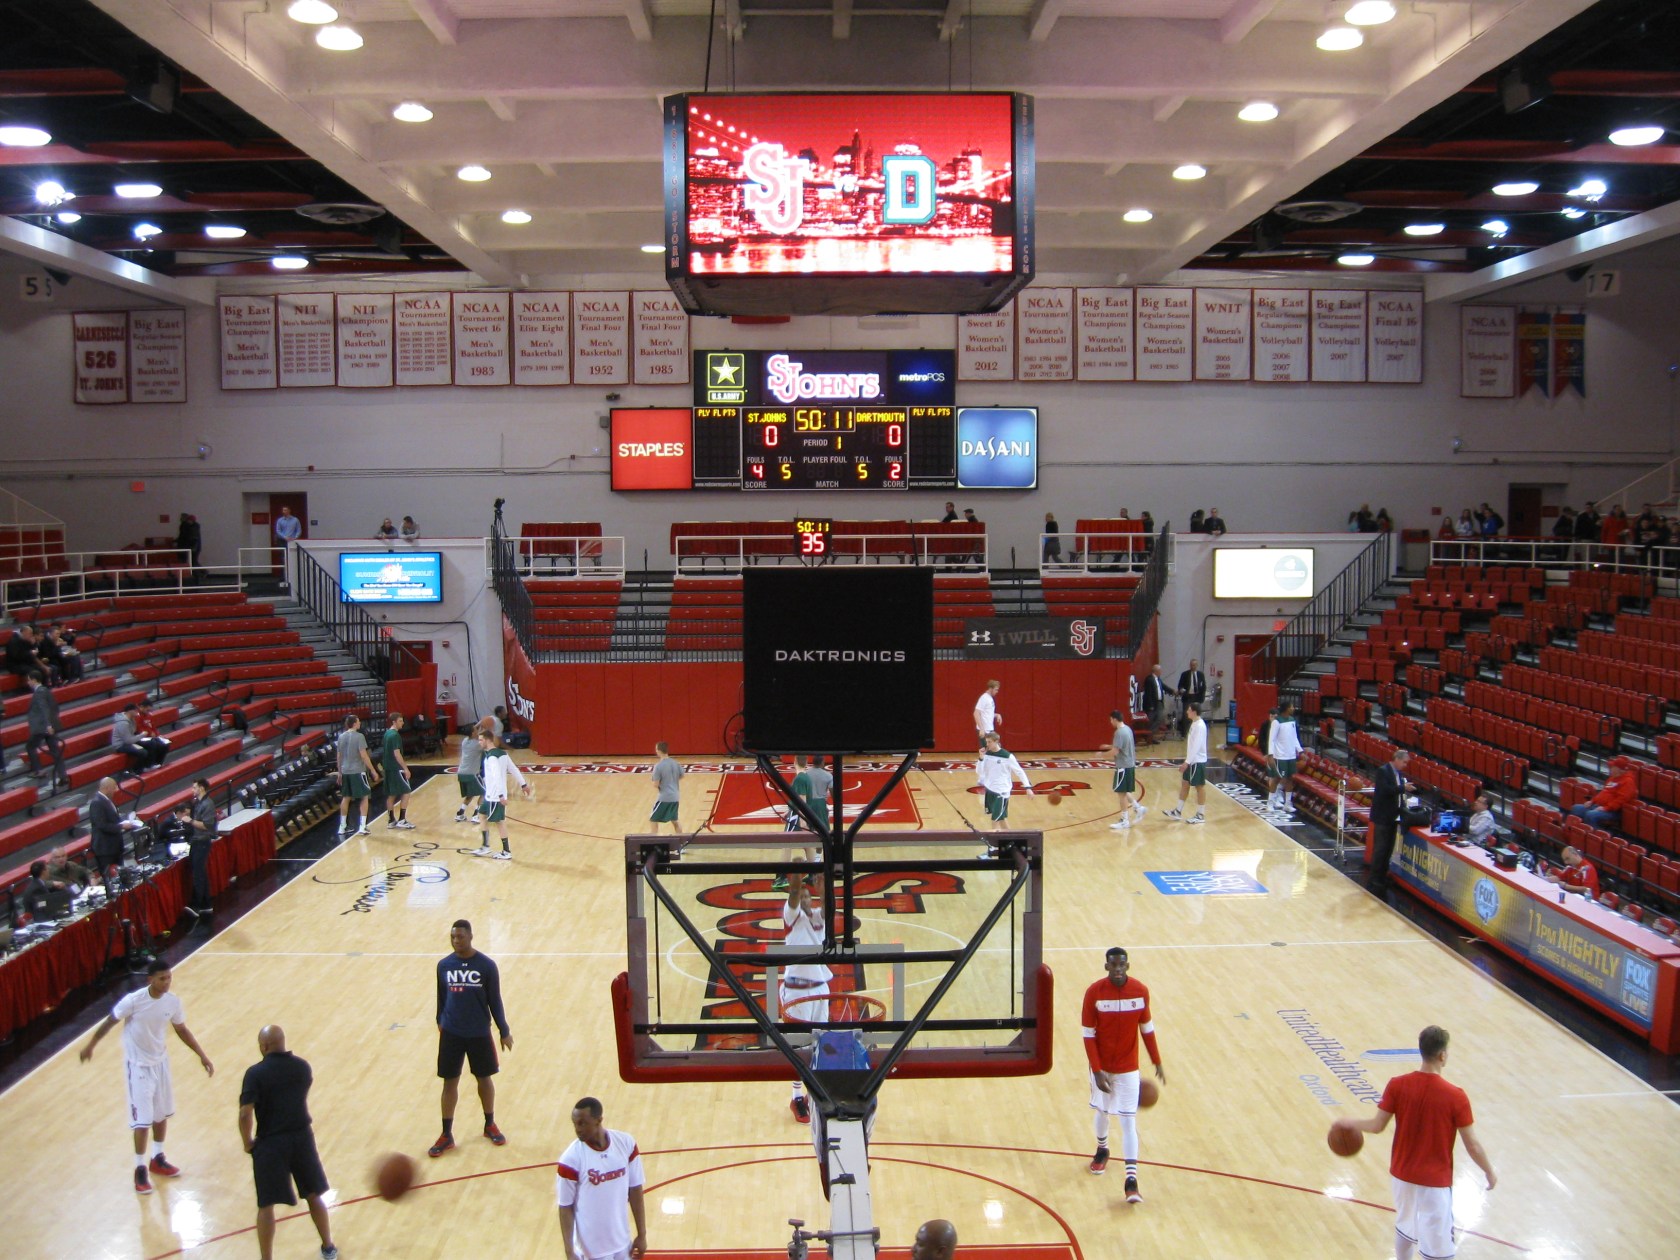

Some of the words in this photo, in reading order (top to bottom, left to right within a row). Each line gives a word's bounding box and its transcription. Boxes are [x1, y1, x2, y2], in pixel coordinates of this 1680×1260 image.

[882, 155, 937, 224] D
[404, 300, 441, 310] NCAA
[463, 303, 501, 313] NCAA
[522, 303, 560, 313] NCAA
[583, 302, 620, 312] NCAA
[643, 302, 680, 311] NCAA
[1028, 298, 1064, 308] NCAA
[1082, 297, 1100, 310] Big
[1105, 297, 1128, 307] East
[1141, 298, 1160, 310] Big
[1165, 298, 1187, 307] East
[1204, 303, 1242, 313] WNIT
[1258, 298, 1276, 310] Big
[1281, 298, 1304, 307] East
[1316, 300, 1333, 312] Big
[1339, 300, 1361, 309] East
[1378, 301, 1414, 311] NCAA
[224, 305, 242, 318] Big
[248, 305, 270, 315] East
[294, 305, 319, 315] NIT
[353, 305, 377, 315] NIT
[1139, 312, 1165, 320] Regular
[134, 320, 152, 332] Big
[157, 319, 180, 328] East
[342, 317, 388, 326] Champions
[1084, 321, 1126, 329] Champions
[1143, 322, 1185, 331] Champions
[1260, 322, 1302, 331] Champions
[1318, 322, 1360, 331] Champions
[1375, 317, 1401, 326] Final
[542, 325, 564, 334] Eight
[641, 323, 661, 331] Final
[227, 329, 269, 337] Champions
[1025, 336, 1067, 344] Basketball
[1147, 337, 1182, 345] Women's
[1203, 336, 1244, 344] Basketball
[1261, 337, 1303, 347] Volleyball
[1318, 337, 1360, 348] Volleyball
[1375, 338, 1416, 349] Volleyball
[237, 343, 260, 351] Men's
[1143, 346, 1185, 354] Basketball
[85, 351, 117, 368] 526
[227, 353, 269, 361] Basketball
[471, 367, 495, 376] 1983
[589, 366, 613, 375] 1952
[650, 365, 674, 374] 1985
[975, 362, 998, 371] 2012
[899, 372, 945, 382] metroPCS
[698, 409, 710, 417] PLY
[713, 409, 722, 417] FL
[723, 409, 736, 417] PTS
[913, 408, 925, 416] PLY
[928, 408, 936, 416] FL
[937, 408, 951, 416] PTS
[796, 409, 853, 431] 50:11
[856, 412, 905, 423] DARTMOUTH
[764, 425, 778, 446] 0
[888, 424, 901, 446] 0
[803, 439, 828, 447] PERIOD
[836, 436, 842, 449] 1
[618, 442, 684, 457] STAPLES
[962, 436, 1030, 460] DASANI
[747, 456, 765, 464] FOULS
[803, 456, 828, 464] PLAYER
[884, 455, 903, 463] FOULS
[752, 464, 763, 479] 4
[781, 463, 792, 480] 5
[858, 463, 868, 480] 5
[890, 463, 901, 480] 2
[745, 480, 767, 488] SCORE
[815, 480, 839, 488] MATCH
[882, 480, 905, 488] SCORE
[796, 521, 830, 533] 50:11
[802, 532, 825, 553] 35
[775, 650, 906, 662] DAKTRONICS
[1480, 884, 1494, 904] FOX
[1558, 927, 1620, 979] NIGHTLY
[447, 970, 482, 983] NYC
[1625, 958, 1650, 990] FOX
[1622, 990, 1648, 1018] LIVE
[1276, 1008, 1382, 1104] UnitedHealthcare
